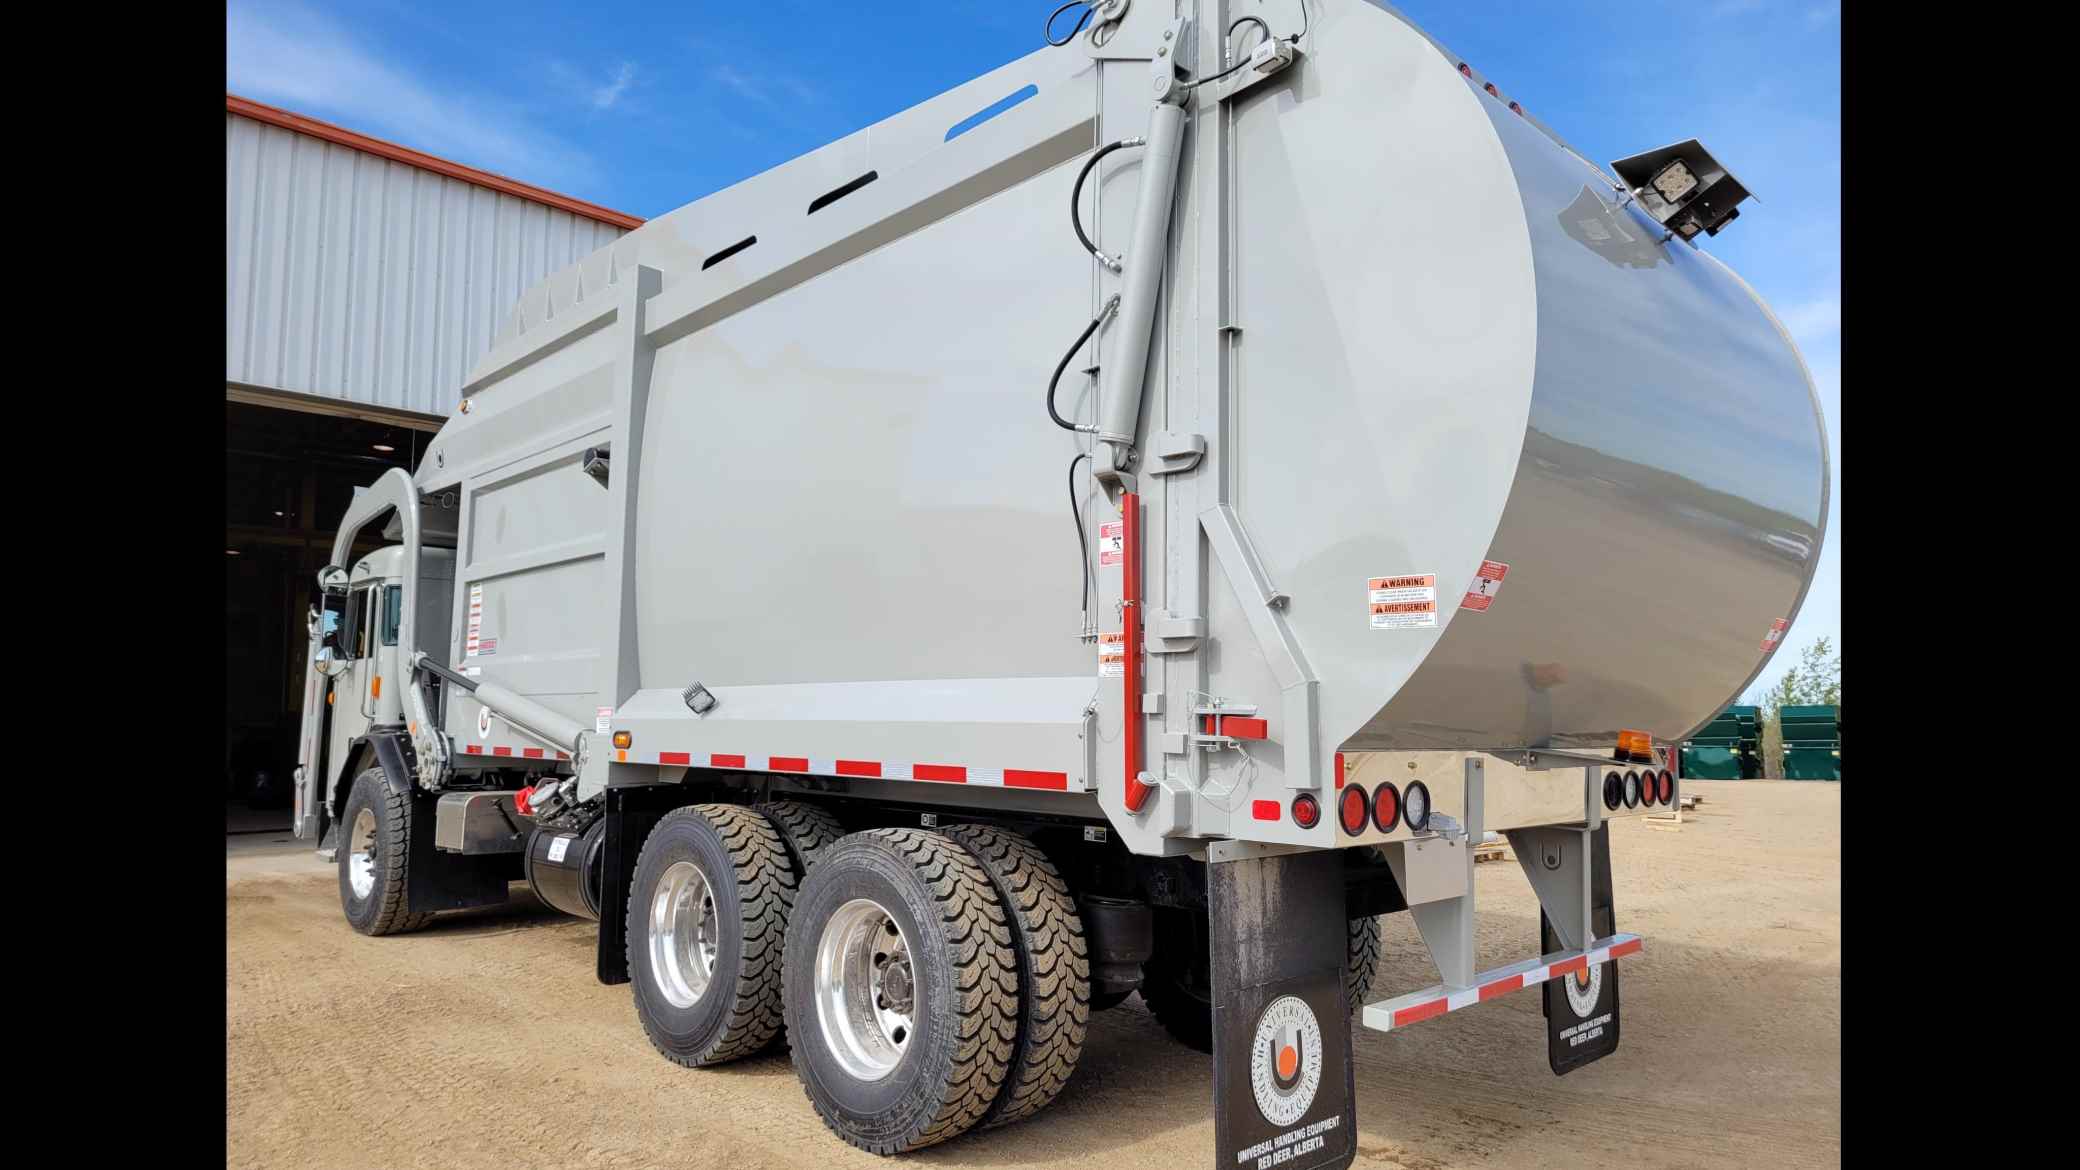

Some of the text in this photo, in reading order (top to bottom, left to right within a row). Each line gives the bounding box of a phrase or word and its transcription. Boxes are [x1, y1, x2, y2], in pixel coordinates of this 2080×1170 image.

[1389, 577, 1425, 588] WARNING
[1384, 602, 1430, 613] AVERTISSEMENT
[1237, 1115, 1340, 1164] UNIVERSAL HANDLING EQUIPMENT
[1258, 1154, 1272, 1170] RED
[1294, 1135, 1324, 1157] ALBERTA
